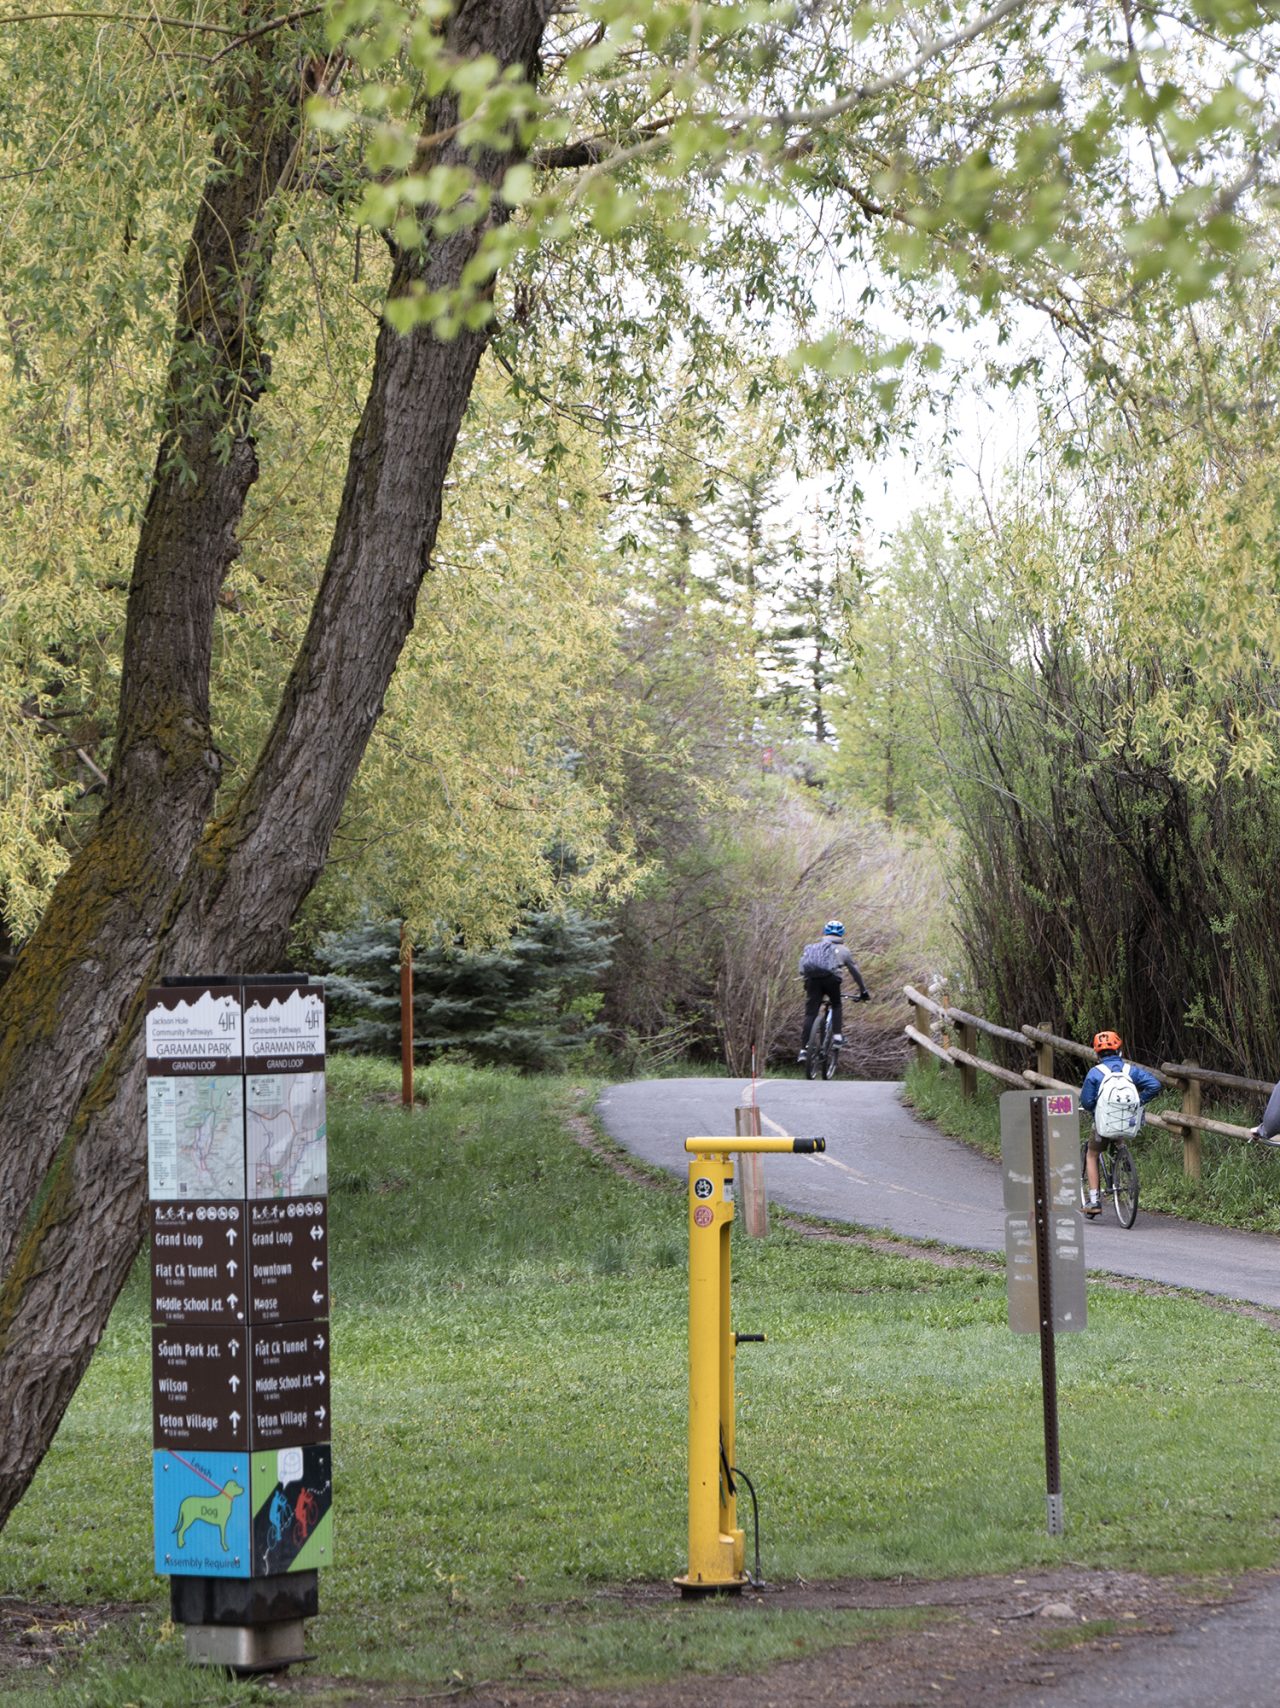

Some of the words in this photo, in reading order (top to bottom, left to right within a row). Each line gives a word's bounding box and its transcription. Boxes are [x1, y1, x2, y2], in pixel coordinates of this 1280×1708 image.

[152, 1016, 174, 1025] Jackson
[175, 1016, 189, 1025] Hole
[249, 1015, 268, 1023] Jackson
[152, 1028, 185, 1037] Community
[186, 1027, 213, 1036] Pathways
[249, 1026, 277, 1035] Community
[156, 1043, 206, 1055] GARAMAN
[207, 1042, 232, 1054] PARK
[253, 1042, 295, 1054] GARAMAN
[296, 1040, 316, 1052] PARK
[172, 1062, 197, 1071] GRAND
[197, 1061, 217, 1071] LOOP
[266, 1060, 287, 1069] GRAND
[288, 1058, 304, 1068] LOOP
[155, 1232, 181, 1246] Grand
[183, 1233, 204, 1249] Loop
[252, 1231, 274, 1246] Grand
[276, 1231, 293, 1247] Loop
[155, 1263, 172, 1277] Flat
[174, 1264, 185, 1277] Ck
[187, 1264, 218, 1278] Tunnel
[253, 1262, 293, 1278] Downtown
[156, 1297, 182, 1311] Middle
[183, 1297, 210, 1311] School
[211, 1298, 224, 1311] Jct.
[254, 1297, 278, 1312] Moose
[158, 1342, 182, 1357] South
[184, 1343, 204, 1357] Park
[206, 1344, 221, 1357] Jct.
[255, 1342, 270, 1357] Flat
[271, 1341, 281, 1355] Ck
[282, 1338, 308, 1354] Tunnel
[158, 1378, 188, 1393] Wilson
[255, 1378, 278, 1393] Middle
[279, 1375, 301, 1390] School
[302, 1374, 313, 1388] Jct.
[159, 1413, 184, 1428] Teton
[186, 1413, 219, 1432] Village
[257, 1414, 279, 1429] Teton
[280, 1411, 308, 1427] Village
[200, 1505, 219, 1519] Dog
[164, 1557, 204, 1570] Assembly
[204, 1558, 242, 1570] Required
